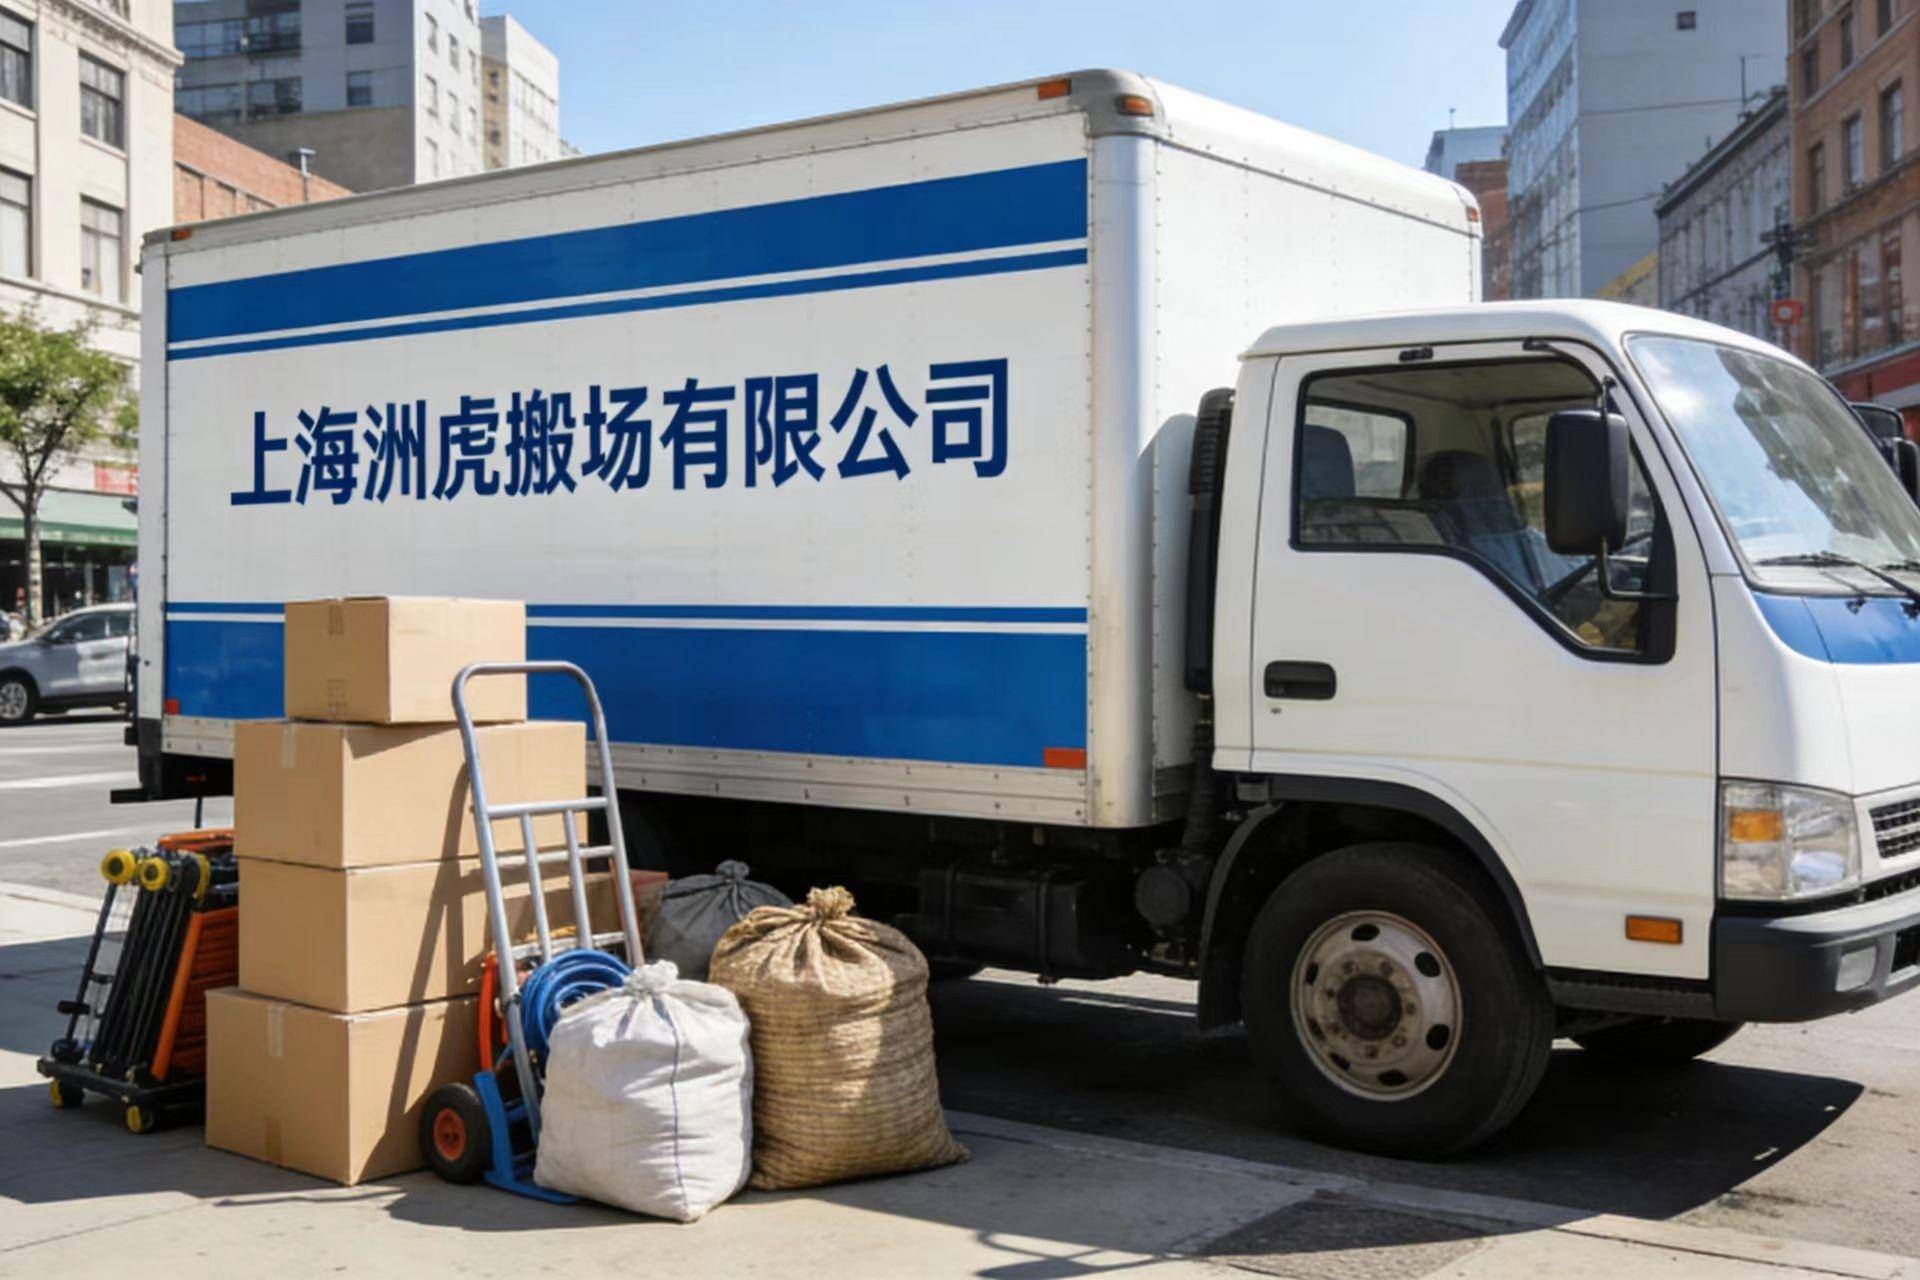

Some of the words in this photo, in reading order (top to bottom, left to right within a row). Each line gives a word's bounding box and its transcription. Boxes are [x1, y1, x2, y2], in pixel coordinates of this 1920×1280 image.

[230, 358, 1009, 506] 上海洲虎搬场有限公司
